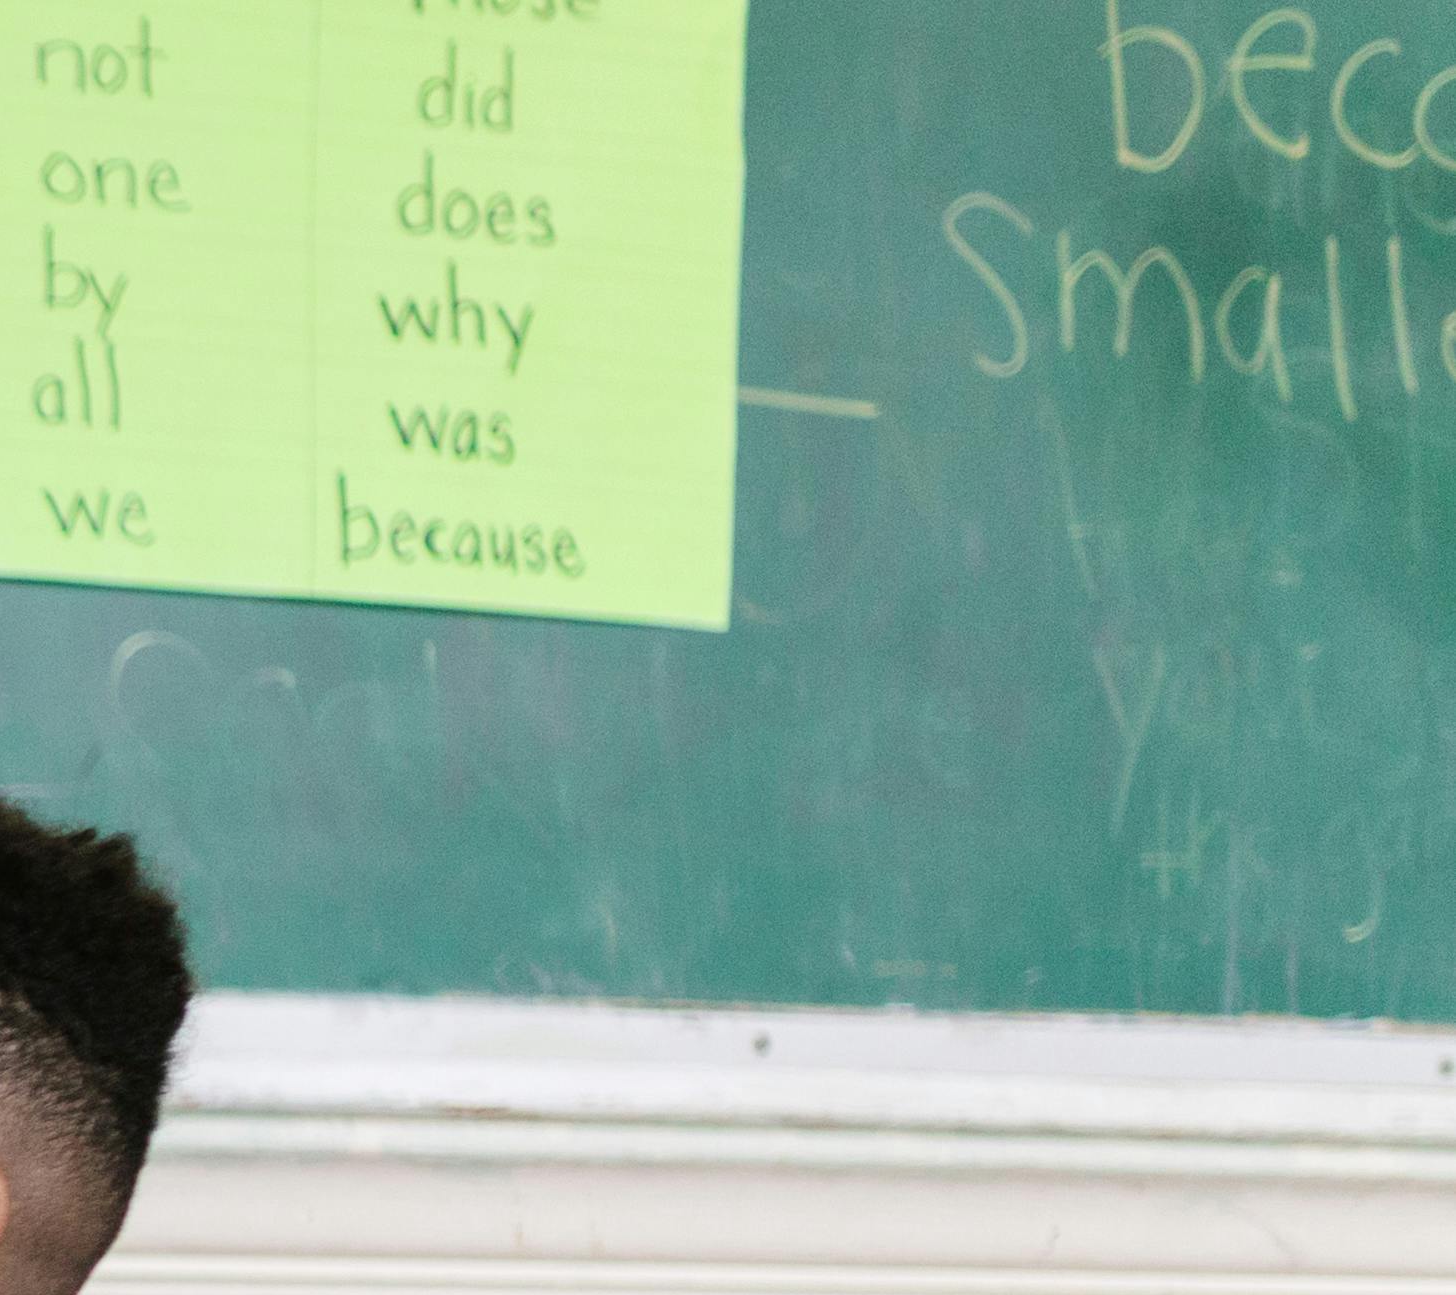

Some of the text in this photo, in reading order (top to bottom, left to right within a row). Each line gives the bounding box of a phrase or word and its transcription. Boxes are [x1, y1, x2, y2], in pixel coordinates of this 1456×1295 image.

[35, 15, 168, 100] not
[416, 37, 514, 133] did
[40, 149, 192, 213] one
[396, 150, 558, 247] does
[43, 223, 127, 338] by
[378, 259, 533, 376] why
[34, 335, 121, 432] all
[388, 401, 517, 467] was
[43, 482, 155, 546] we
[337, 470, 586, 579] because
